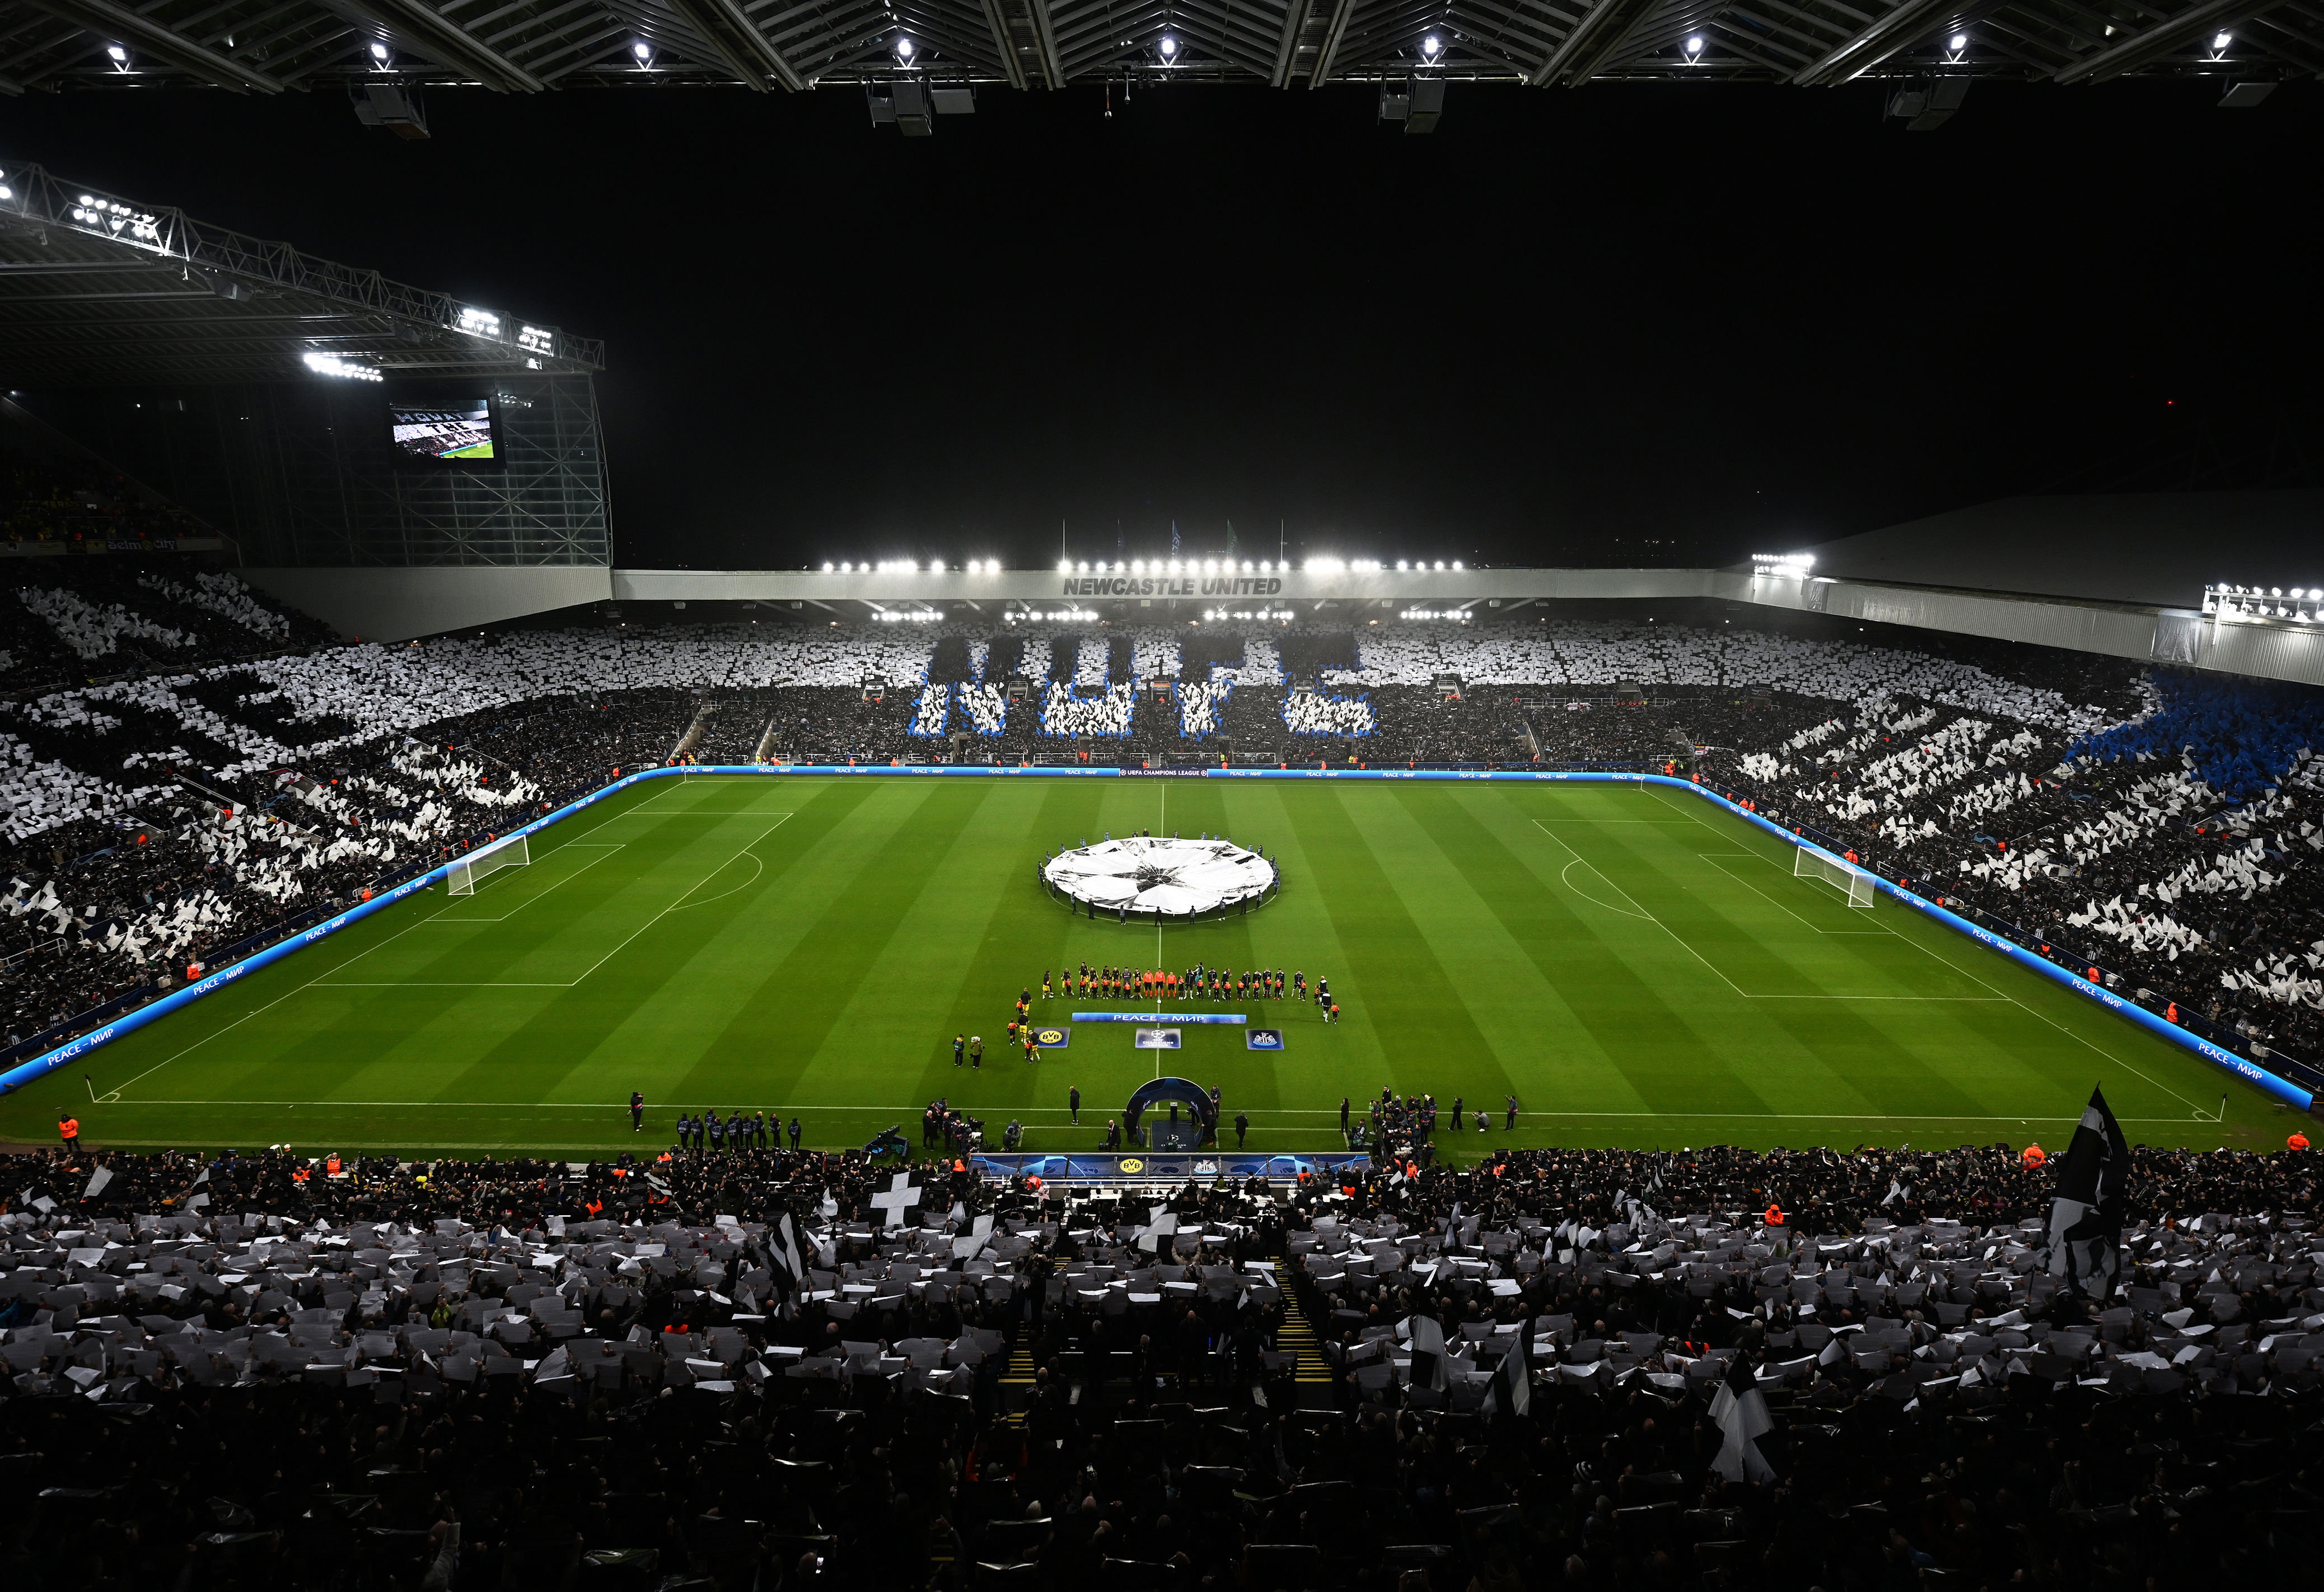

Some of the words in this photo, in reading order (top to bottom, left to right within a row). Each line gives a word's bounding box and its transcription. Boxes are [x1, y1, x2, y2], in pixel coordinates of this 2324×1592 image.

[1063, 578, 1195, 595] NEWCASTLE
[1201, 578, 1282, 595] UNITED
[394, 885, 411, 898] PEACE
[415, 877, 427, 888] МИР
[1893, 888, 1909, 900] PEACE
[1913, 898, 1926, 908] МИР
[306, 926, 326, 941] PEACE
[331, 917, 346, 929] МИР
[1972, 928, 1992, 943] PEACE
[1997, 940, 2013, 952] МИР
[193, 978, 219, 996] PEACE
[226, 966, 244, 980] МИР
[2072, 978, 2096, 996] PEACE
[2102, 994, 2122, 1008] МИР
[48, 1044, 82, 1066] PEACE
[91, 1028, 114, 1045] МИР
[2199, 1043, 2229, 1064] PEACE
[2237, 1063, 2262, 1079] МИР
